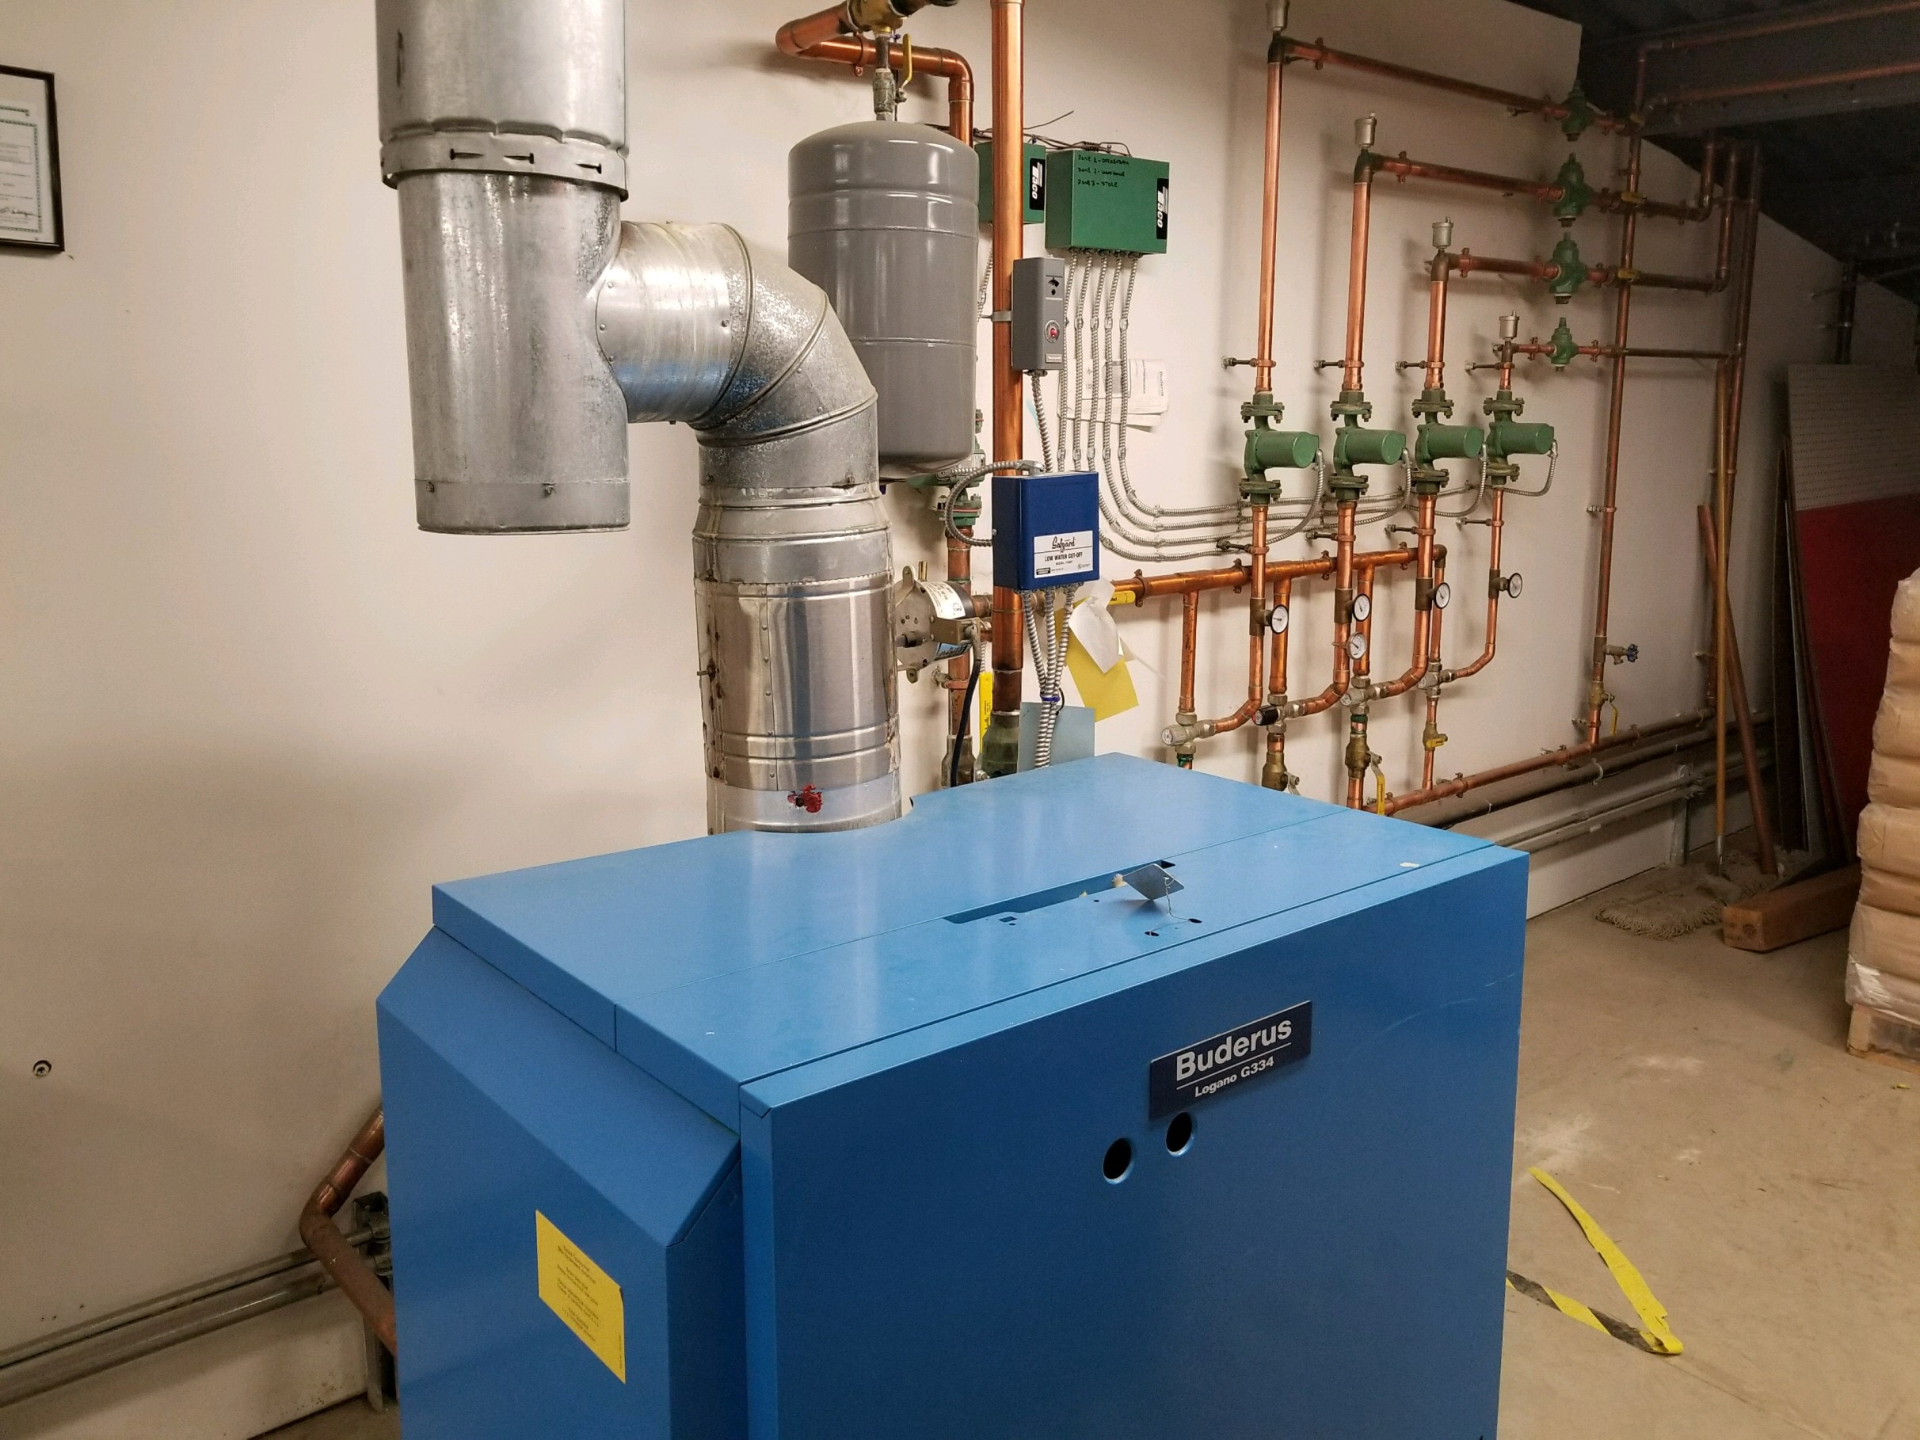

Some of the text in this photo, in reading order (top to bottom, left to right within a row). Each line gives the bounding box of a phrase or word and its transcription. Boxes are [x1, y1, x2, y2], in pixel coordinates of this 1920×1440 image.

[1176, 1019, 1292, 1081] Buderus
[1195, 1056, 1274, 1097] Logano G334
